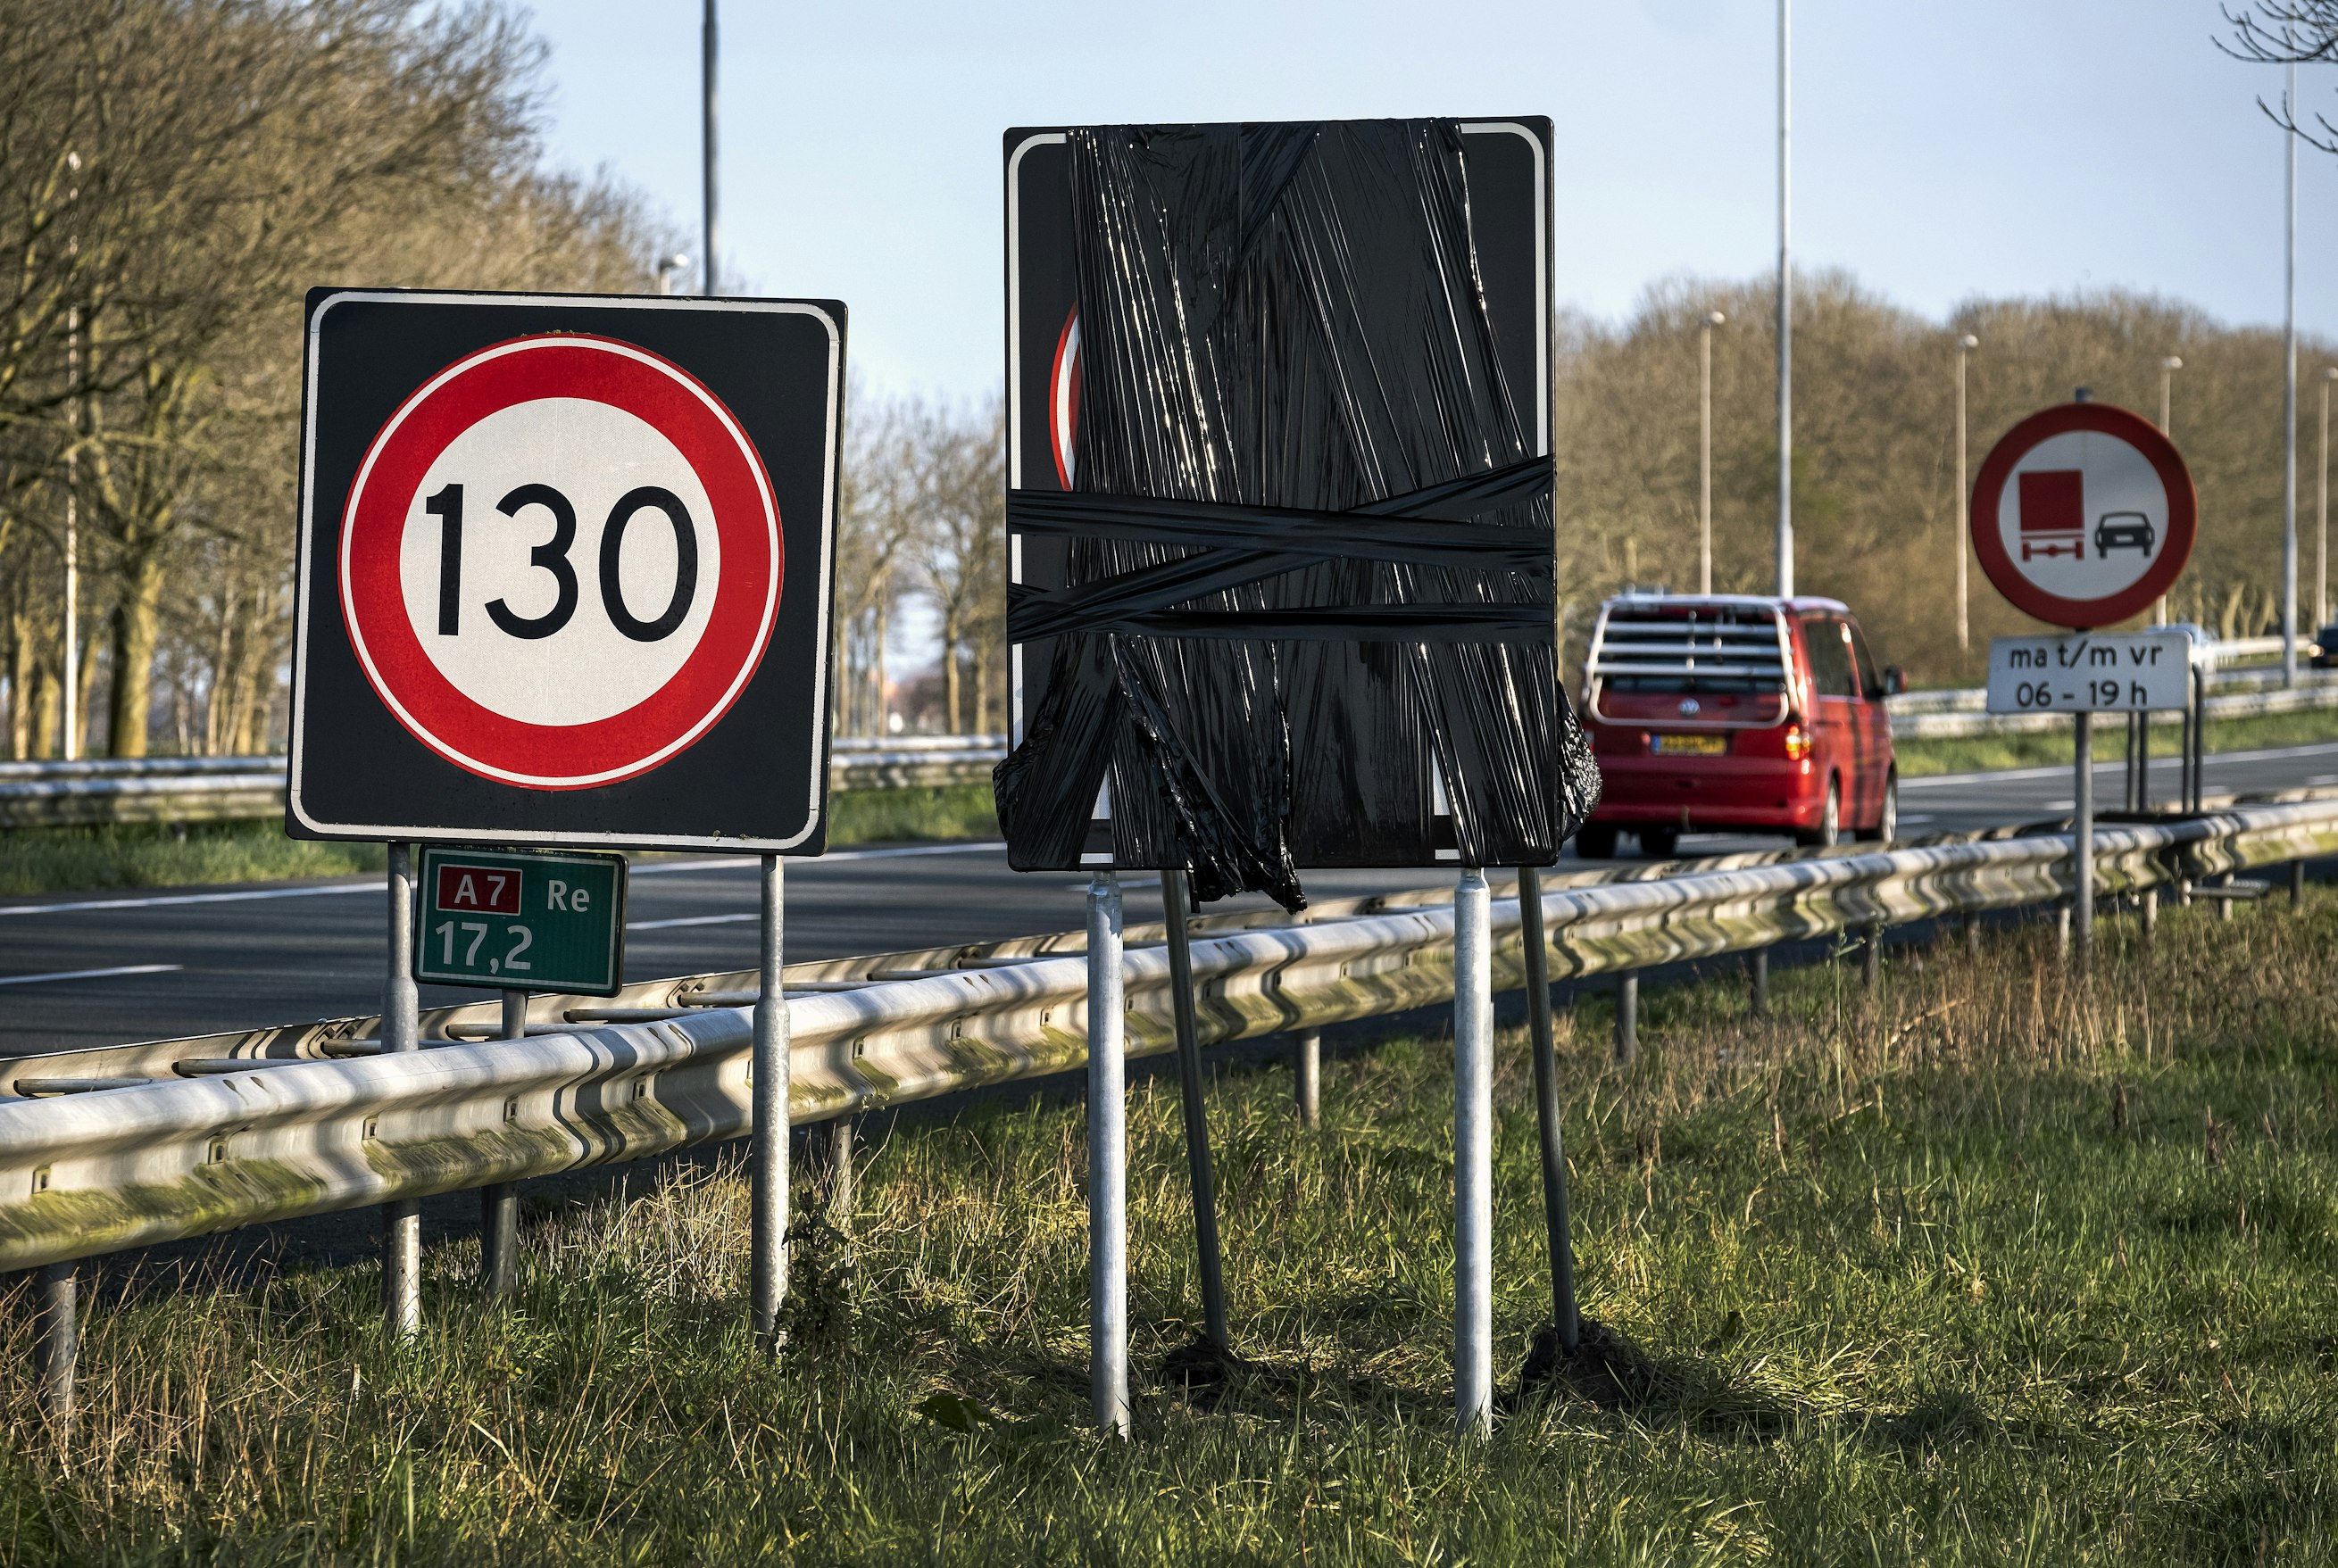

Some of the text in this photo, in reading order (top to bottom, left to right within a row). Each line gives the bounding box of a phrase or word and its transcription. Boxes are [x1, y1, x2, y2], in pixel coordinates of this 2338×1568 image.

[426, 483, 698, 643] 130
[2010, 640, 2164, 668] ma t/m vr
[2017, 682, 2052, 708] 06
[2089, 681, 2119, 706] 19
[2132, 680, 2148, 705] h
[547, 879, 590, 913] Re
[435, 920, 533, 975] 17,2
